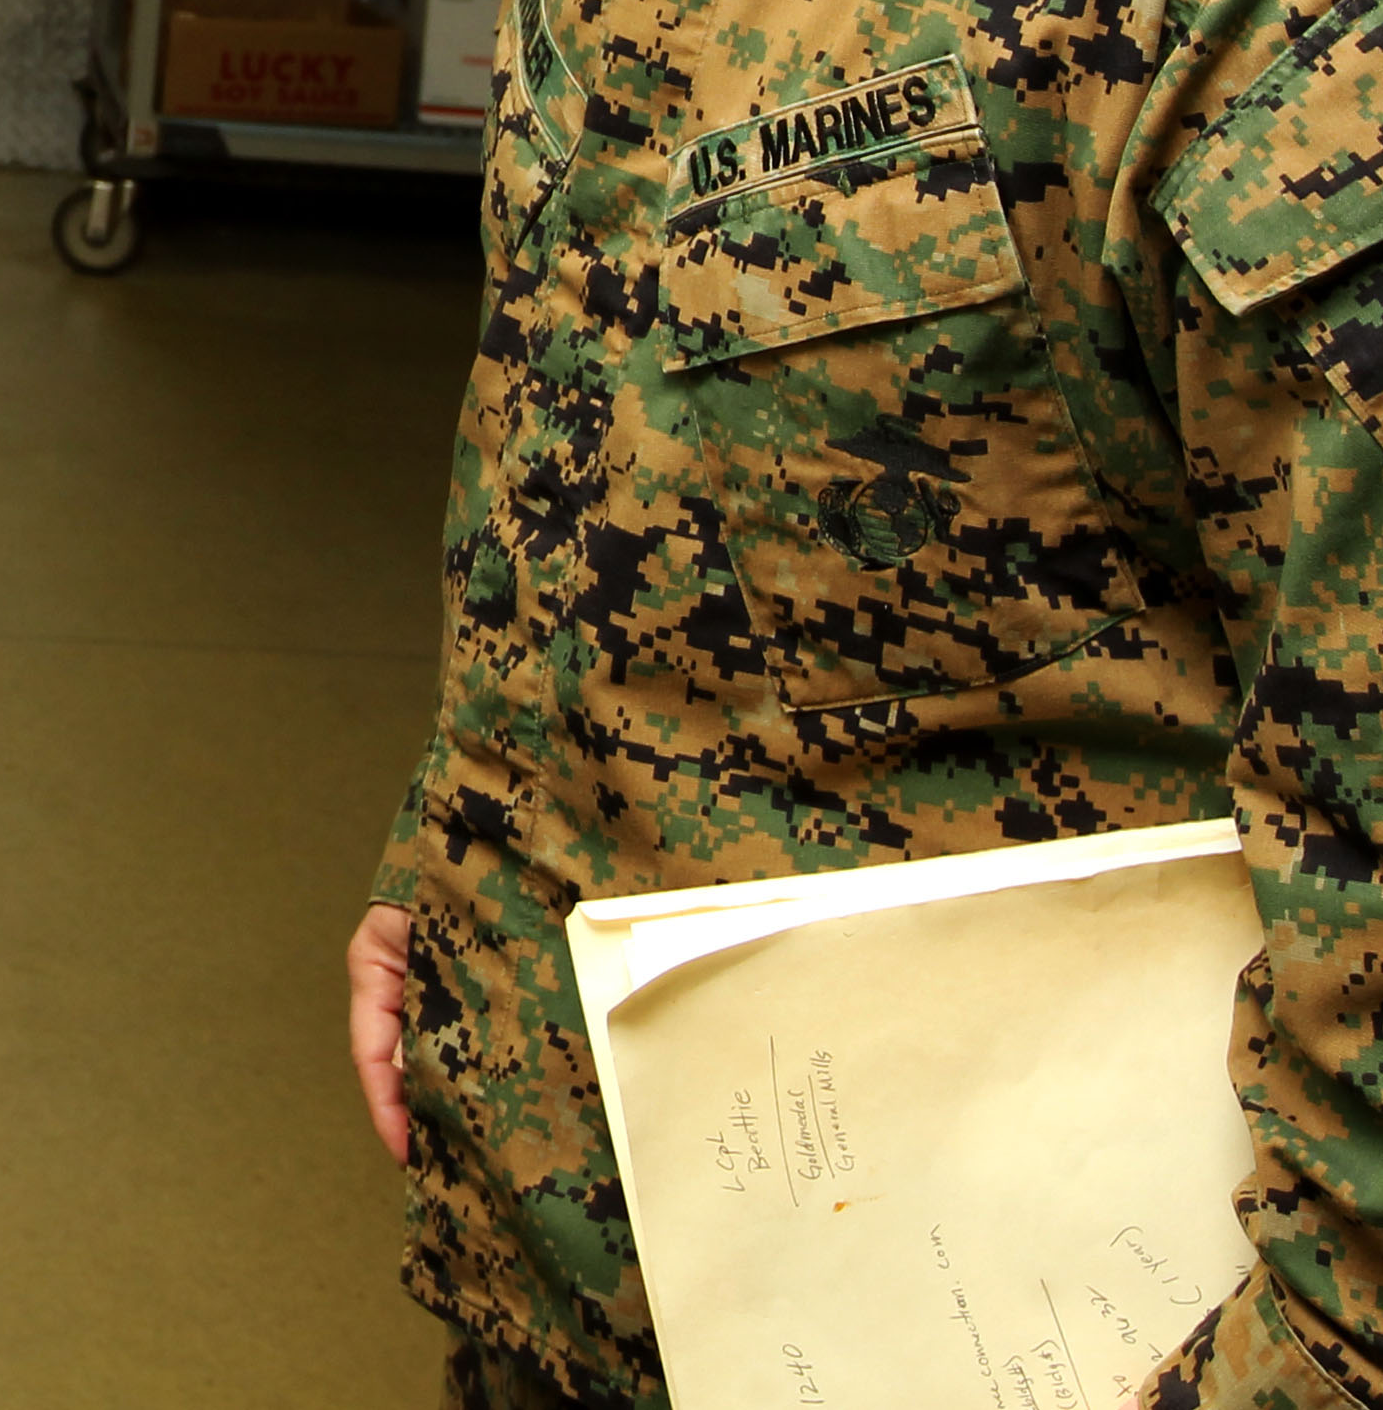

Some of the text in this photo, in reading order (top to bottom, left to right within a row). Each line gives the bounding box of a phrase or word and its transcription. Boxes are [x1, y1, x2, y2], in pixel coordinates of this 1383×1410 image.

[219, 50, 356, 85] LUCKY
[689, 75, 936, 196] U.S. MARINES
[781, 1342, 826, 1404] 1240
